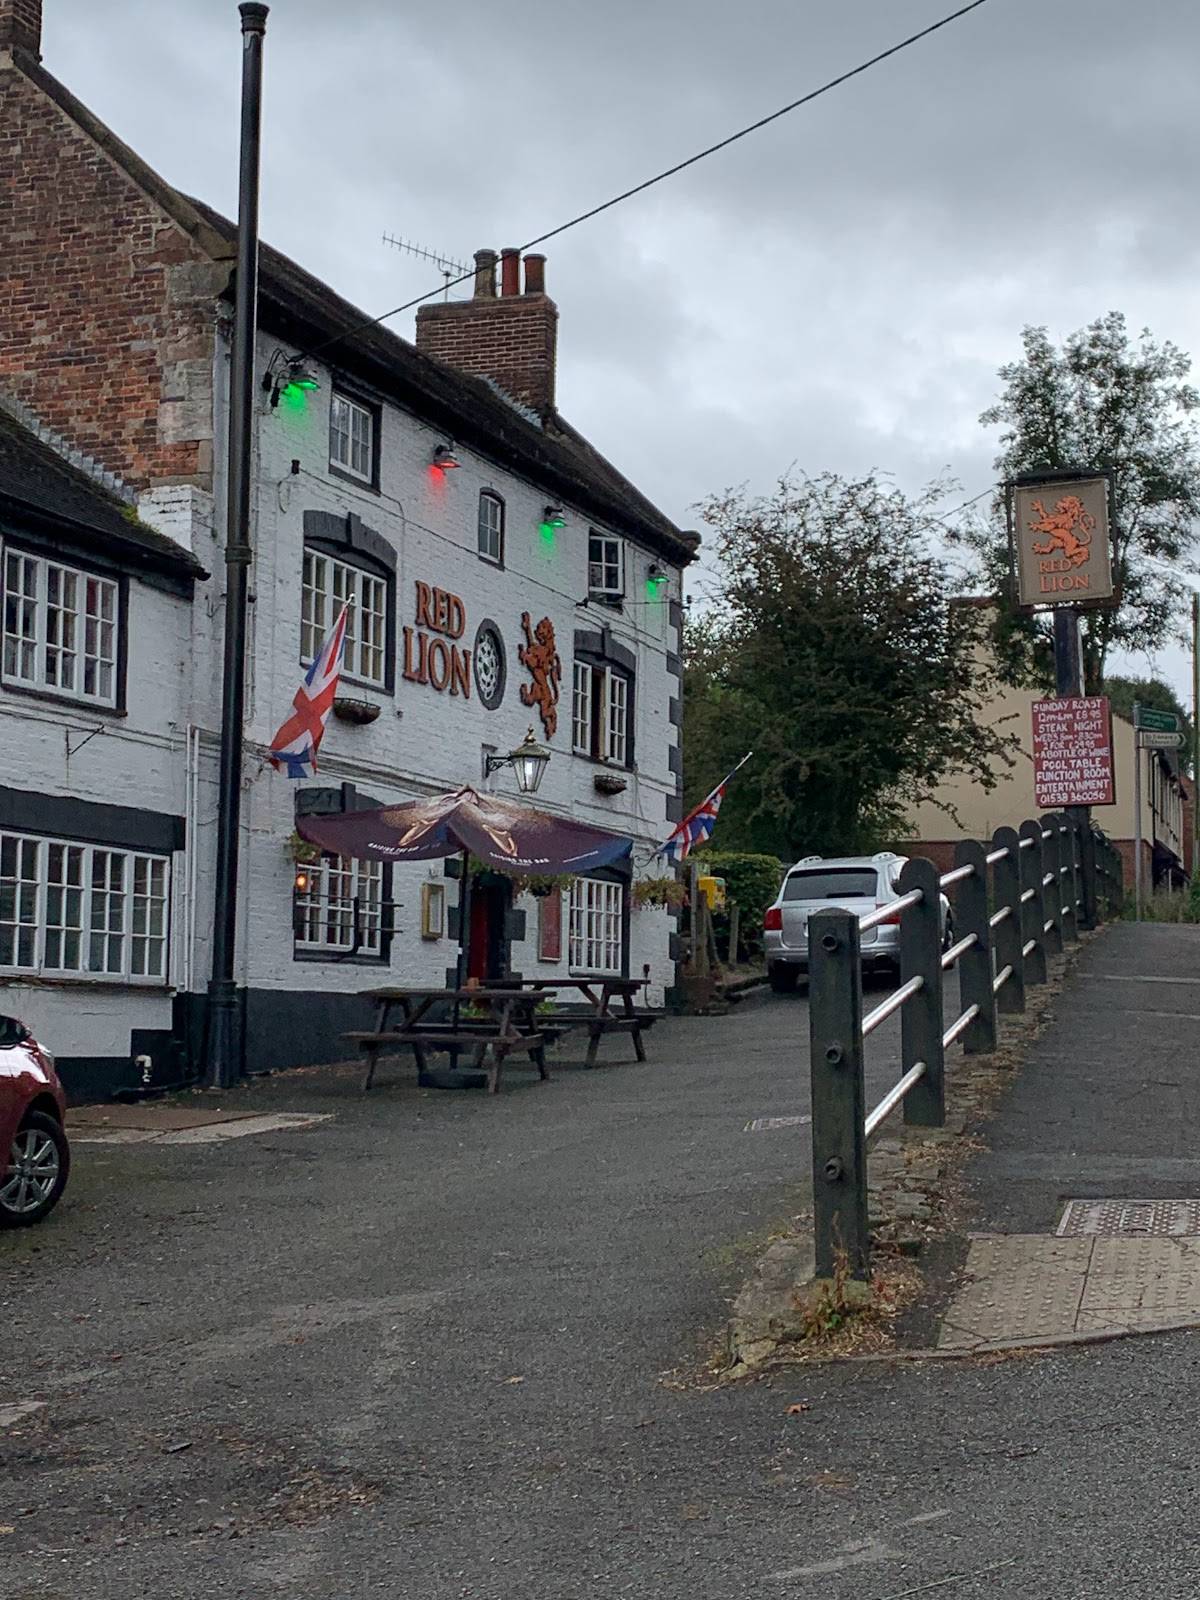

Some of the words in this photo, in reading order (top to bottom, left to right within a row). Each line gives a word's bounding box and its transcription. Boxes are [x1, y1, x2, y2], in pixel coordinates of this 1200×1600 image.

[1040, 560, 1072, 573] RED
[1040, 575, 1090, 593] LION
[415, 580, 466, 640] RED
[402, 626, 472, 699] LION
[1033, 701, 1069, 712] SUNDAY
[1072, 699, 1102, 709] ROAST
[1039, 722, 1068, 733] STEAK
[1074, 720, 1103, 731] NIGHT
[1077, 748, 1088, 757] OF
[1089, 747, 1110, 757] WINE
[1043, 760, 1068, 770] POOL
[1069, 758, 1101, 768] TABLE
[1036, 770, 1080, 781] FUNCTION
[1083, 768, 1110, 778] ROOM
[1036, 779, 1110, 794] ENTERTAINMENT
[1040, 793, 1068, 803] 01538
[1071, 790, 1106, 801] 360056
